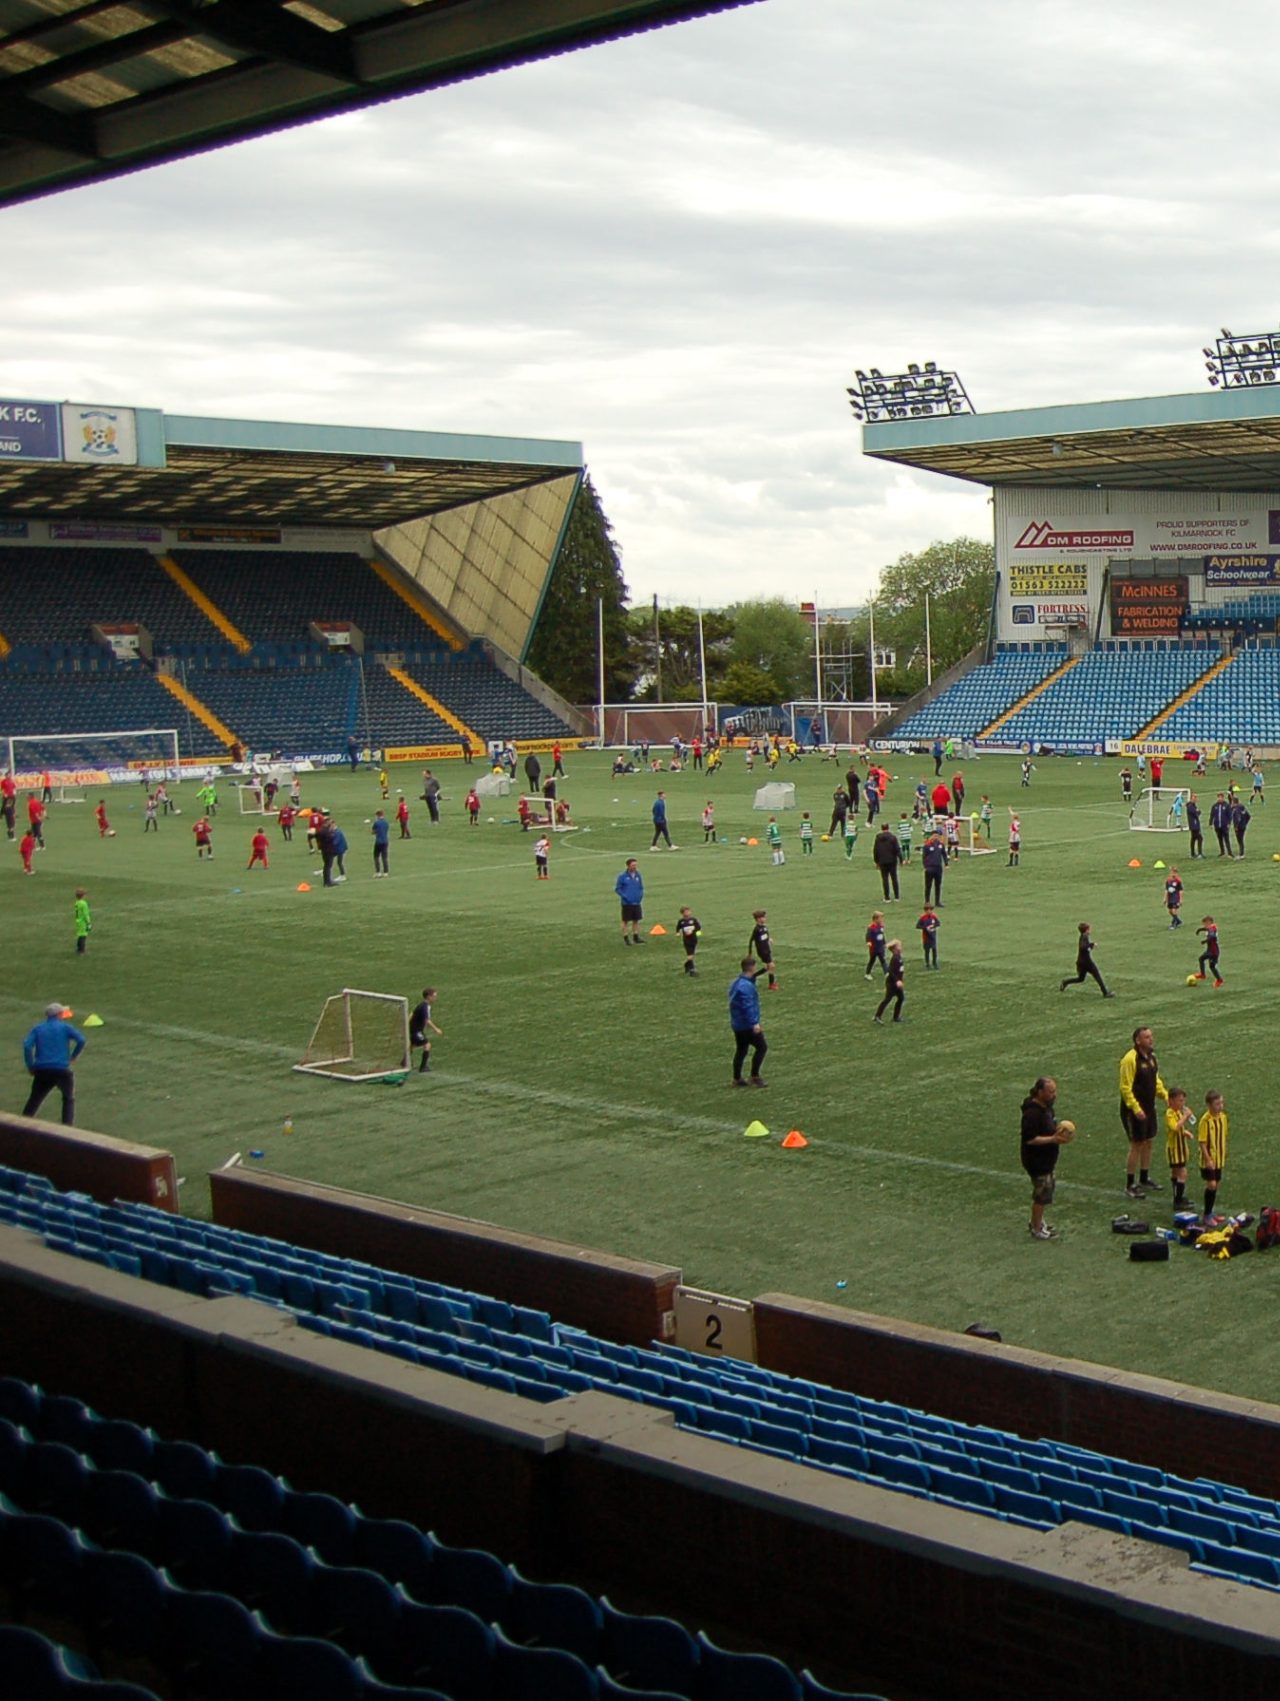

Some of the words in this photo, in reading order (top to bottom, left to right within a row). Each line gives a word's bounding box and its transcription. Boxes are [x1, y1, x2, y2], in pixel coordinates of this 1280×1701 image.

[1156, 520, 1184, 528] PROUD
[1186, 519, 1238, 528] SUPPORTERS
[1047, 536, 1069, 545] DM
[1072, 535, 1132, 545] ROOFING
[1209, 556, 1268, 569] Ayrshire
[1010, 565, 1055, 575] THISTLE
[1057, 564, 1087, 574] CABS
[1206, 570, 1270, 580] Schoolwear
[1011, 581, 1044, 590] 01563
[1048, 580, 1085, 589] 522222
[1121, 584, 1177, 597] McINNES
[1037, 604, 1086, 613] FORTRESS
[1117, 606, 1183, 616] FABRICATION
[1122, 618, 1131, 628] &
[1132, 617, 1178, 628] WELDING
[1125, 744, 1170, 754] DALEBRAE
[705, 1314, 723, 1350] 2
